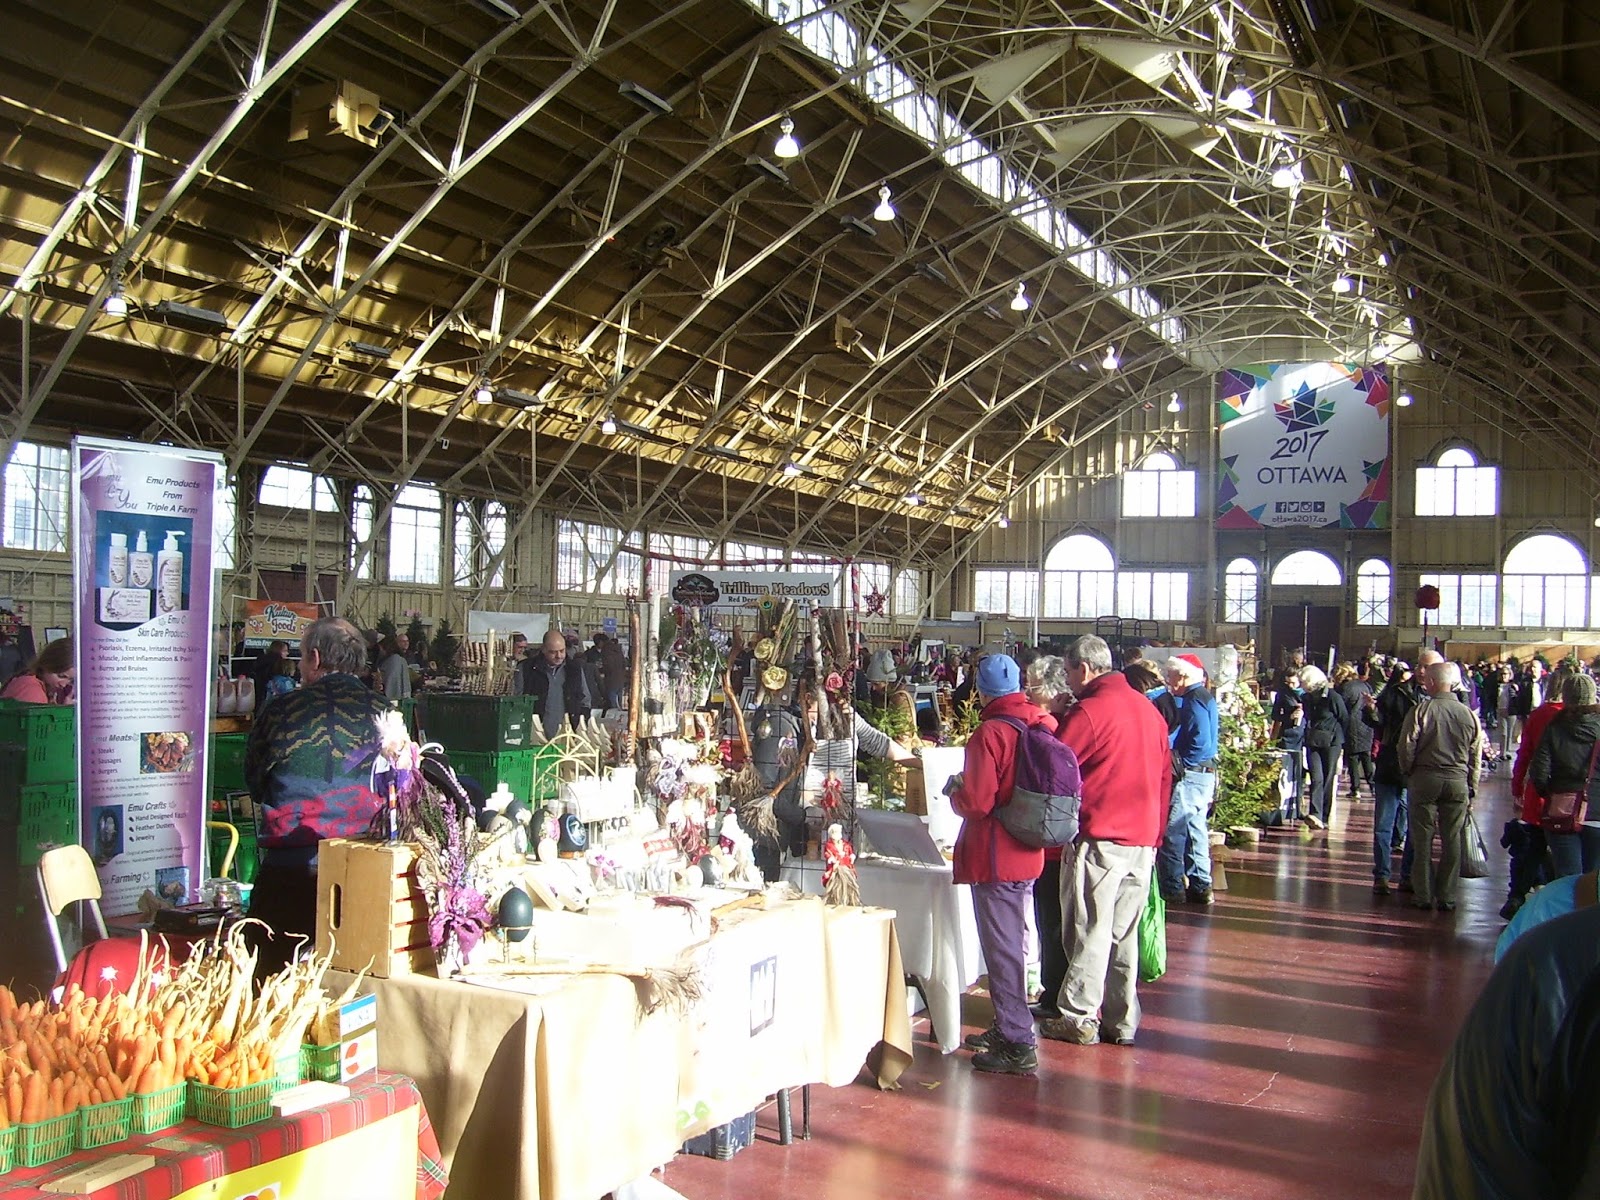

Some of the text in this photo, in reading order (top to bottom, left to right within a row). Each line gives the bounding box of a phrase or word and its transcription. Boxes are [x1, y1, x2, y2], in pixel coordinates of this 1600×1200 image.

[1270, 429, 1330, 463] 2017
[1257, 466, 1348, 484] OTTAWA
[146, 475, 201, 489] Emu Products
[115, 489, 138, 509] You
[162, 491, 183, 500] From
[147, 502, 198, 515] Triple A Farm
[1271, 515, 1328, 523] ottawa2017.ca
[720, 581, 770, 594] Trillium
[137, 628, 190, 638] Skin Care Products
[271, 618, 297, 635] Foods
[108, 734, 133, 742] Meats
[127, 801, 167, 812] Emu Crafts
[111, 872, 142, 883] Farming
